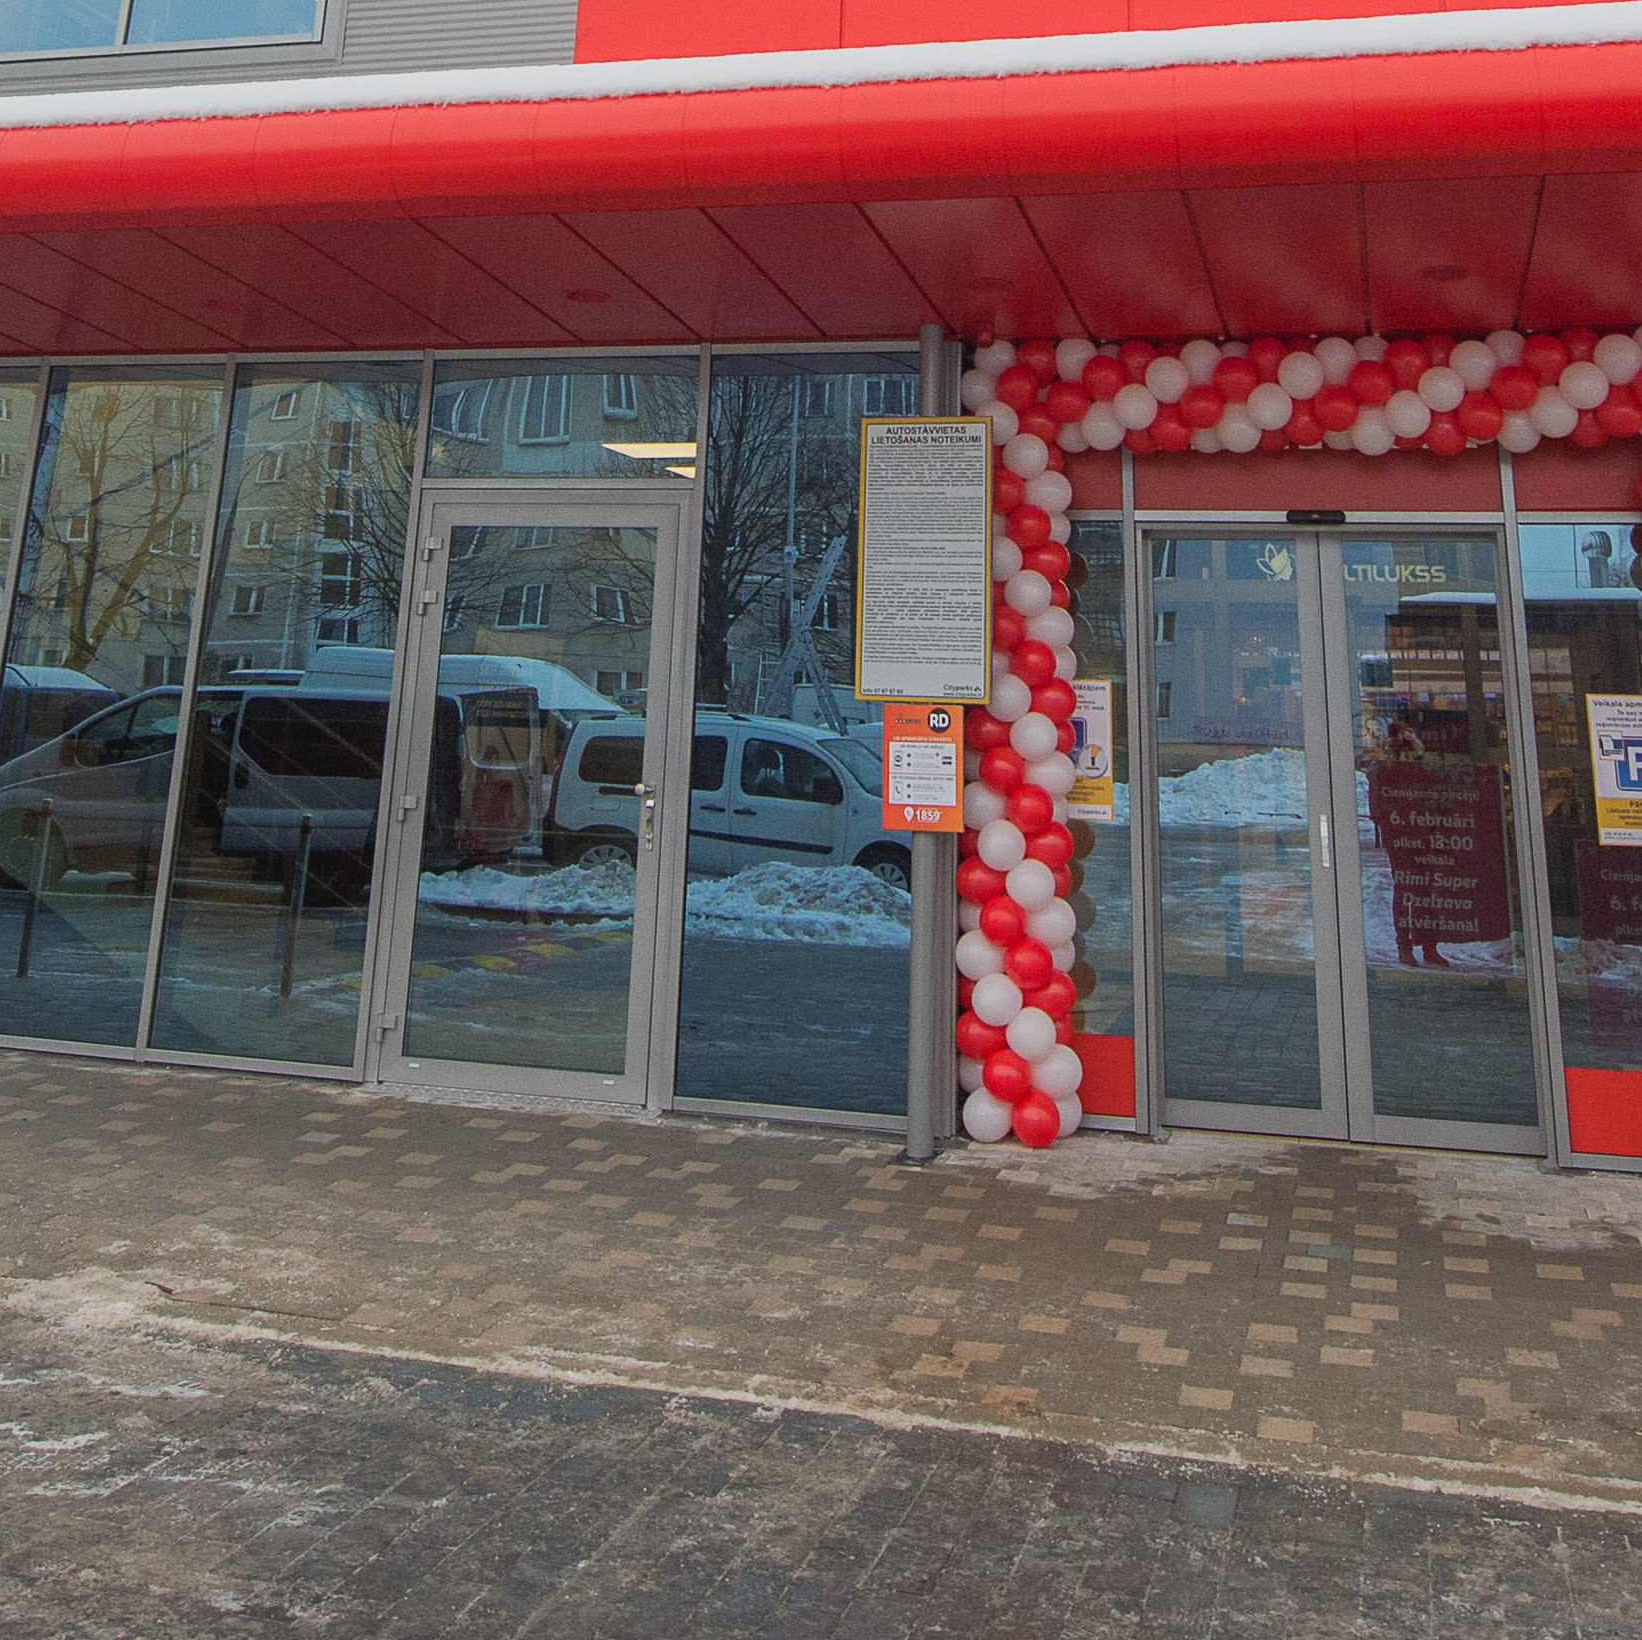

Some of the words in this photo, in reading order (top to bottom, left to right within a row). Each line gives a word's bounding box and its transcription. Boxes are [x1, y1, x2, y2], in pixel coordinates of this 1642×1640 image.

[871, 435, 928, 444] LIETOŠANAS
[931, 435, 982, 444] NOTEIKUMI
[1343, 564, 1447, 583] LTILUKSS
[1593, 700, 1623, 708] Veikala
[929, 713, 949, 728] RD
[1389, 810, 1406, 825] 6.
[1409, 812, 1475, 829] februāri
[1433, 872, 1478, 893] Super
[1610, 896, 1627, 911] 6.
